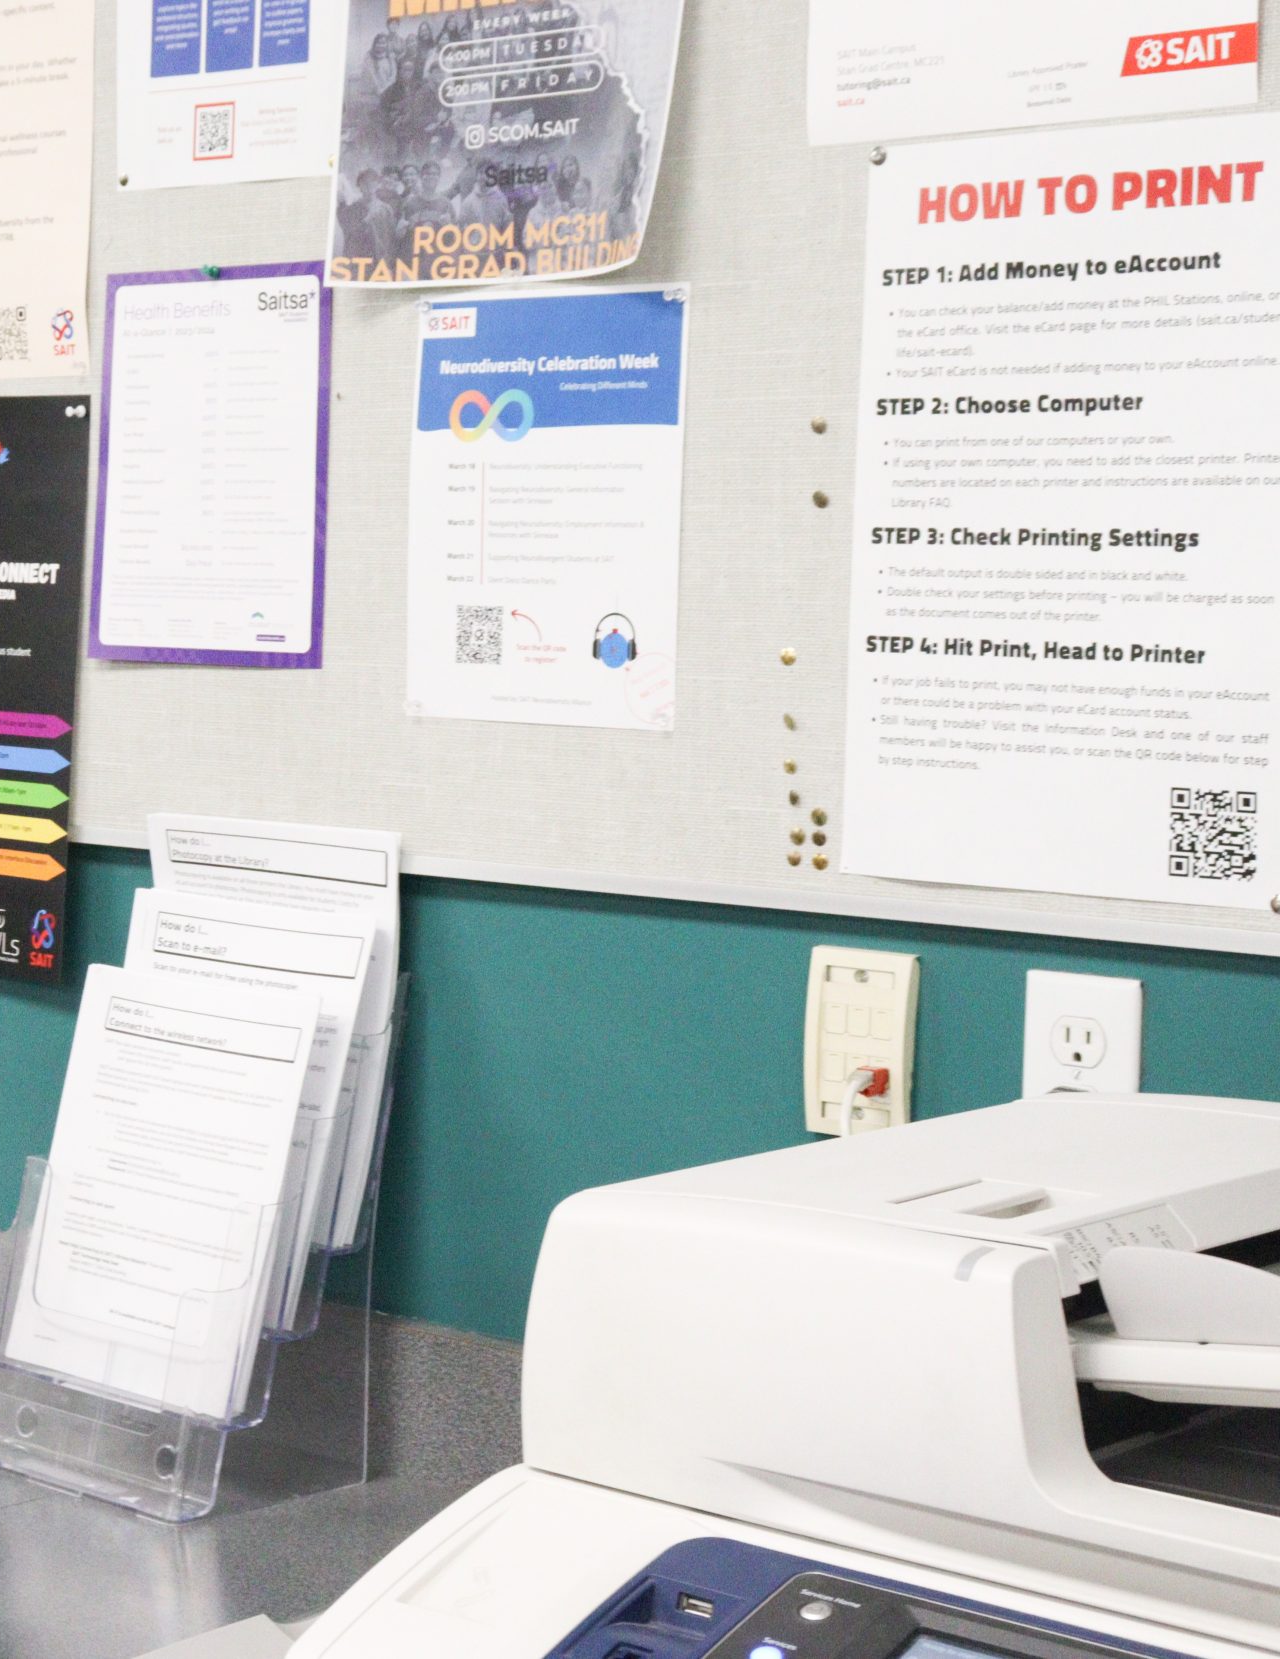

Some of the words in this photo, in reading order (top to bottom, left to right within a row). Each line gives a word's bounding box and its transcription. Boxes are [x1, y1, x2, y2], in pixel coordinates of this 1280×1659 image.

[473, 15, 521, 31] EVERY
[528, 8, 571, 23] WEEK
[1166, 32, 1236, 66] SAIT
[501, 70, 594, 93] FRIDAY
[487, 118, 580, 143] SCOM.SAIT
[919, 180, 1024, 225] HOW
[1038, 175, 1098, 217] TO
[1111, 161, 1265, 212] PRINT
[413, 222, 514, 255] ROOM
[524, 211, 609, 250] MC311
[331, 256, 419, 283] STAN
[430, 252, 527, 281] GRAD
[882, 267, 930, 286] STEP
[938, 266, 953, 283] 1:
[959, 263, 1000, 282] Add
[1005, 262, 1079, 280] Money
[1085, 260, 1108, 276] to
[1114, 253, 1221, 274] eAccount
[441, 315, 470, 331] SAIT
[53, 344, 76, 356] SAIT
[440, 359, 535, 374] Neurodiversity
[538, 357, 616, 370] Celebration
[619, 354, 658, 368] Week
[876, 398, 925, 416] STEP
[932, 397, 949, 415] 2:
[955, 397, 1031, 414] Choose
[1037, 395, 1143, 415] Computer
[871, 527, 921, 544] STEP
[927, 528, 944, 545] 3:
[950, 528, 1011, 546] Check
[1017, 528, 1102, 551] Printing
[1109, 529, 1199, 552] Settings
[866, 636, 914, 653] STEP
[920, 638, 938, 655] 4:
[944, 638, 973, 656] Hit
[979, 639, 1036, 660] Print,
[1043, 642, 1097, 660] Head
[1103, 645, 1124, 662] to
[1130, 644, 1205, 664] Printer
[160, 920, 181, 931] How
[184, 923, 196, 934] do
[157, 937, 179, 949] Scan
[182, 941, 191, 951] to
[29, 952, 54, 969] SAIT
[109, 1017, 142, 1031] Connect
